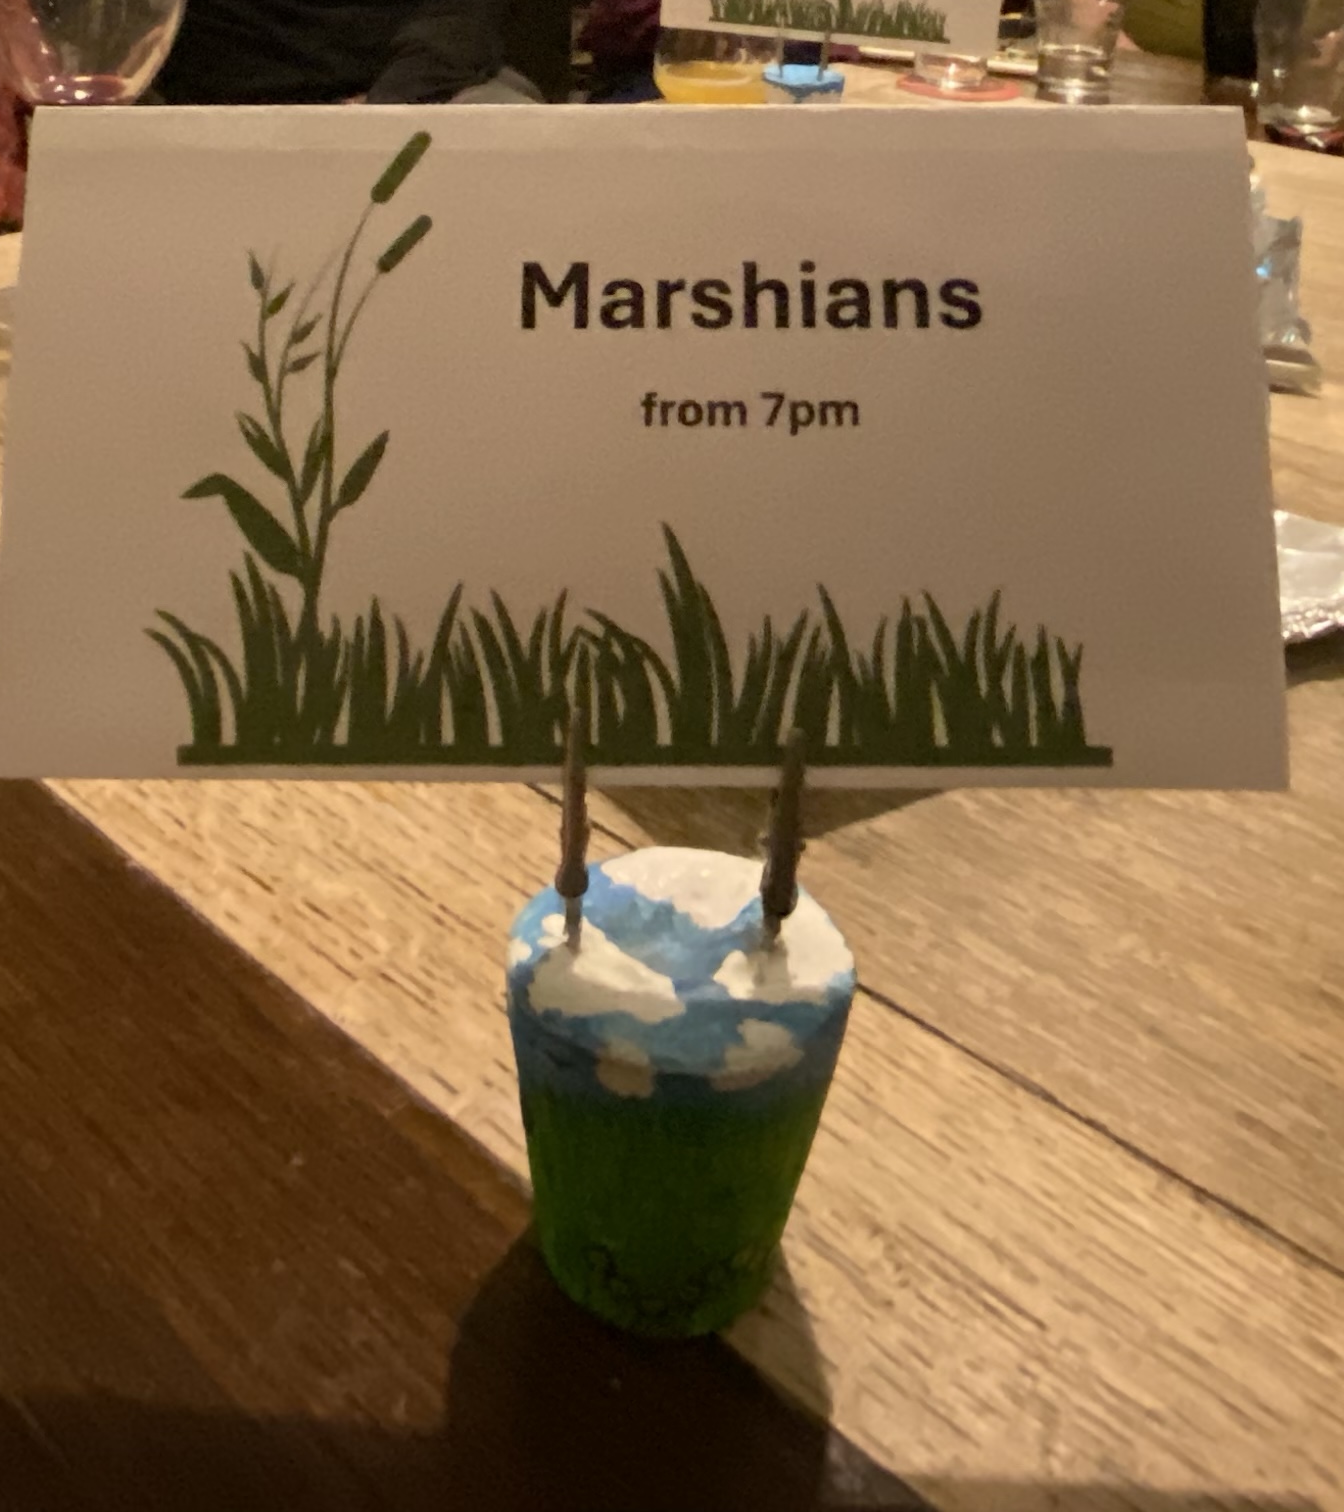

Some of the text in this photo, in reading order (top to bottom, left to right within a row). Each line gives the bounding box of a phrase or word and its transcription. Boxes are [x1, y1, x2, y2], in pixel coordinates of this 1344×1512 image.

[520, 259, 984, 330] Marshians
[640, 391, 861, 437] from 7pm
